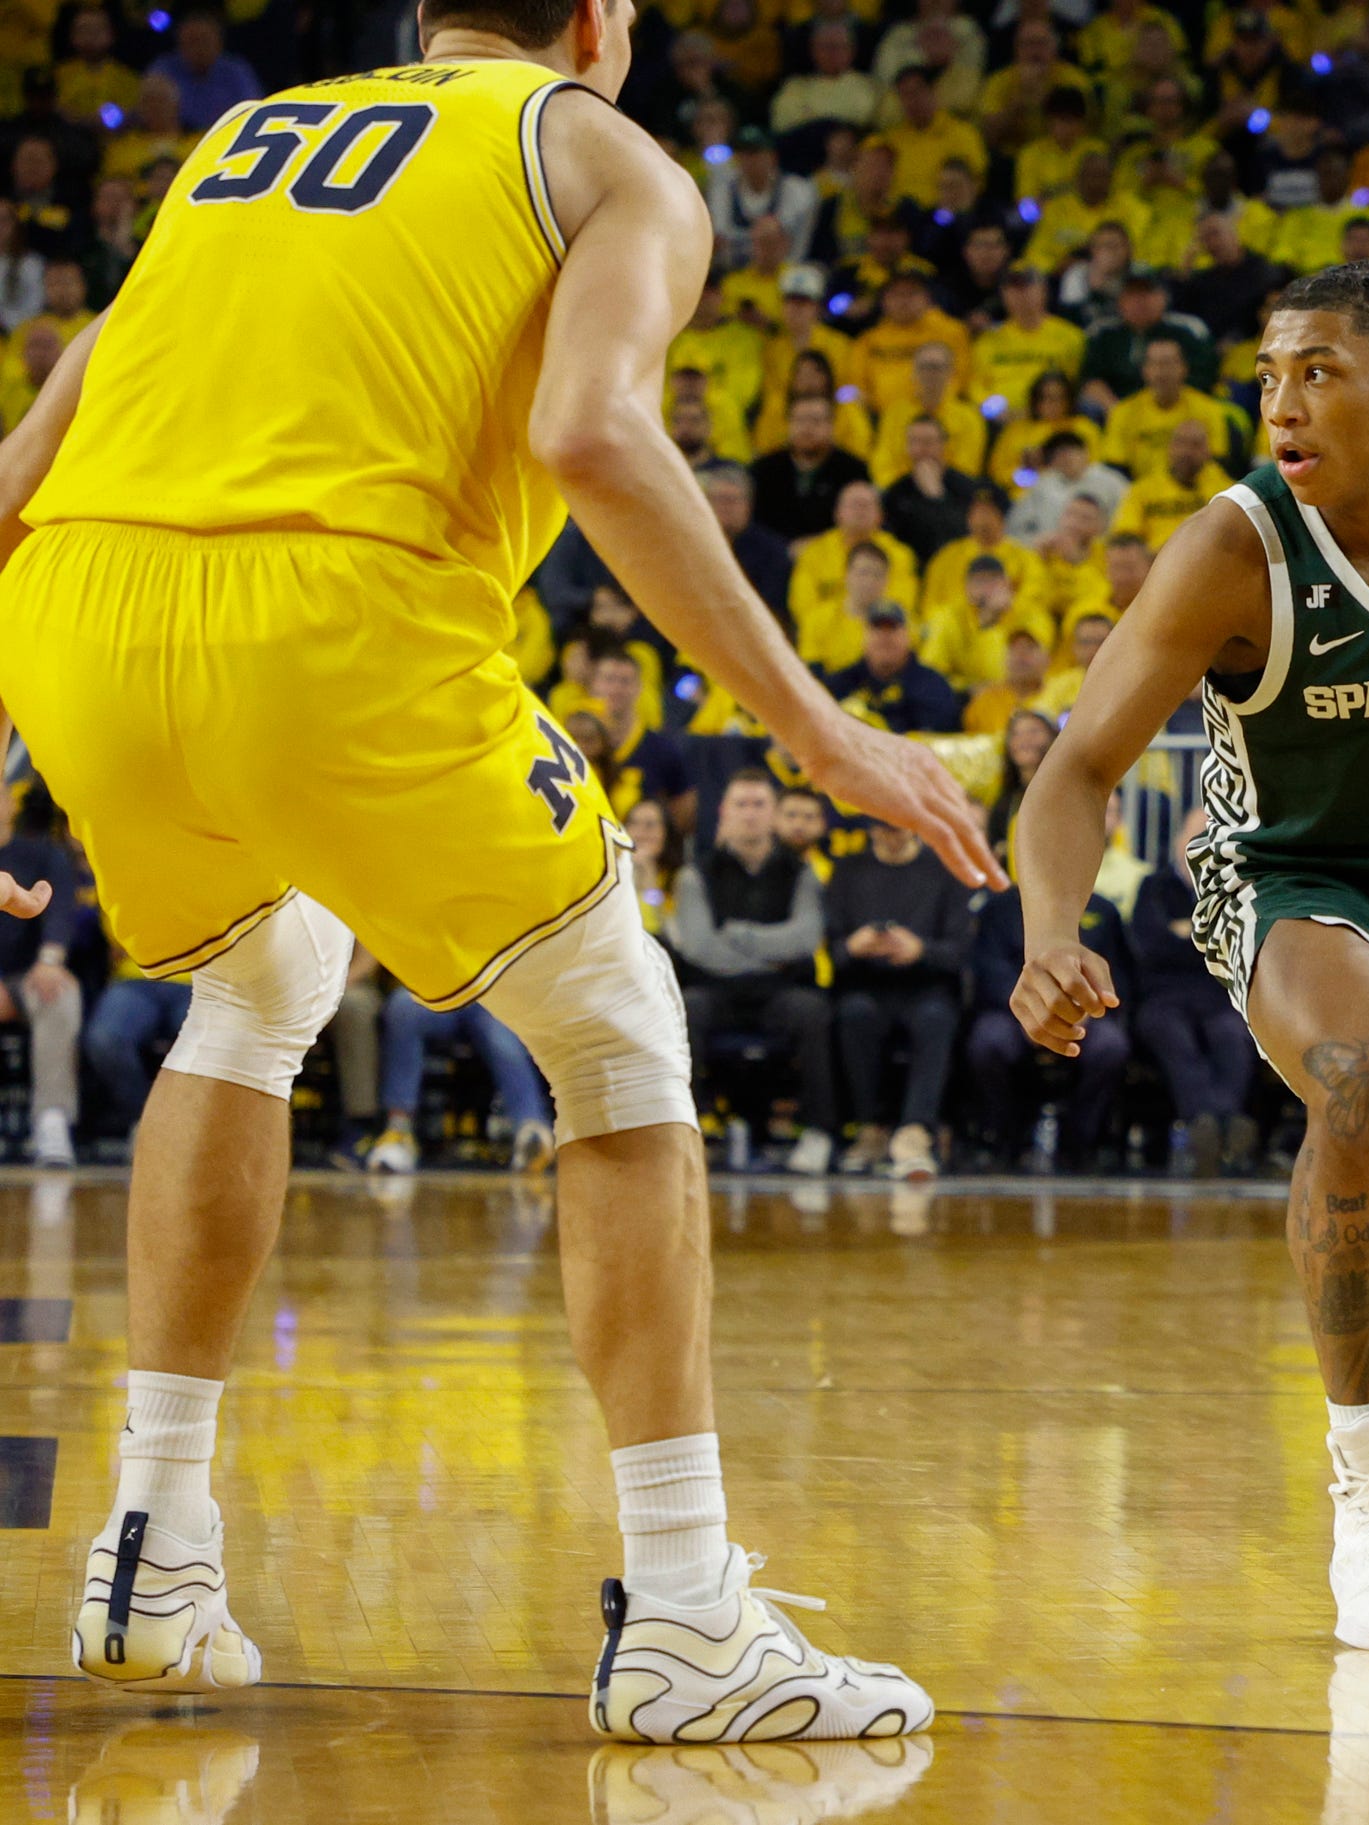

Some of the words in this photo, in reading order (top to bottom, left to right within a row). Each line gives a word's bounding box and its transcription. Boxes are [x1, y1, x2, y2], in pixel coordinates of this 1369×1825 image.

[187, 102, 439, 216] 50
[1305, 584, 1332, 609] JF
[526, 712, 590, 835] M
